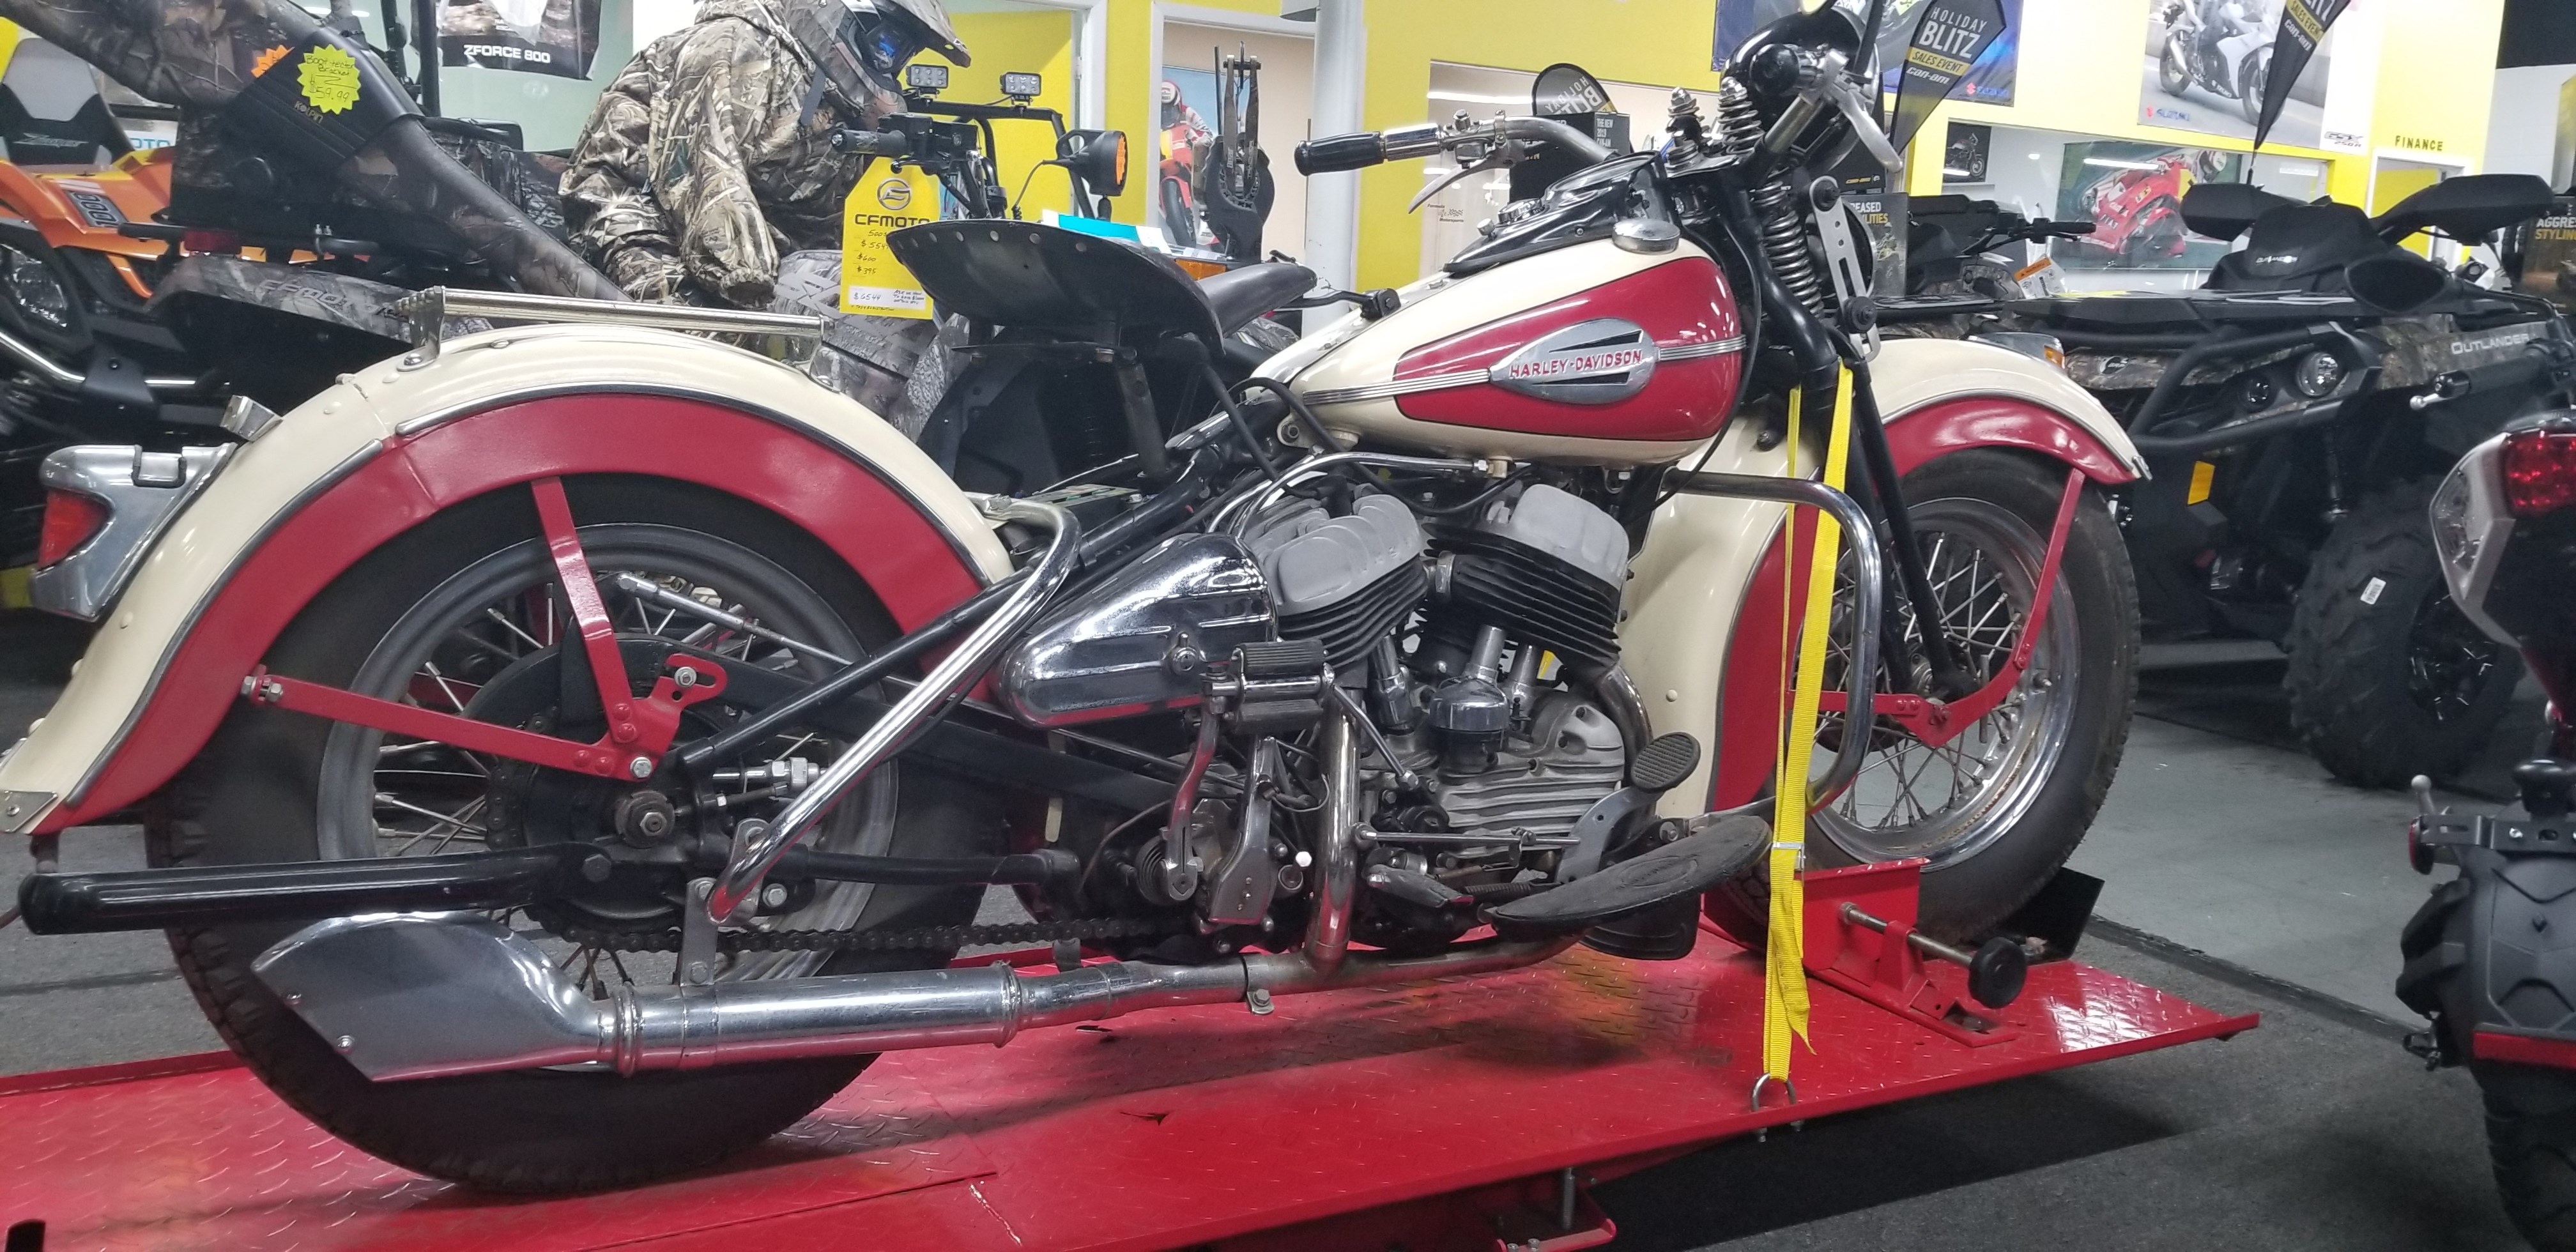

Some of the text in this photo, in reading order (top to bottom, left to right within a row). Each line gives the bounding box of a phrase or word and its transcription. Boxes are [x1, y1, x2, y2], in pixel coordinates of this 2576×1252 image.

[1930, 7, 1988, 33] HOLIDAY
[1919, 20, 1981, 59] BLITZ
[464, 44, 550, 63] ZFORCE 800
[1912, 51, 1963, 73] SALES EVENT
[2395, 135, 2443, 151] FINANCE
